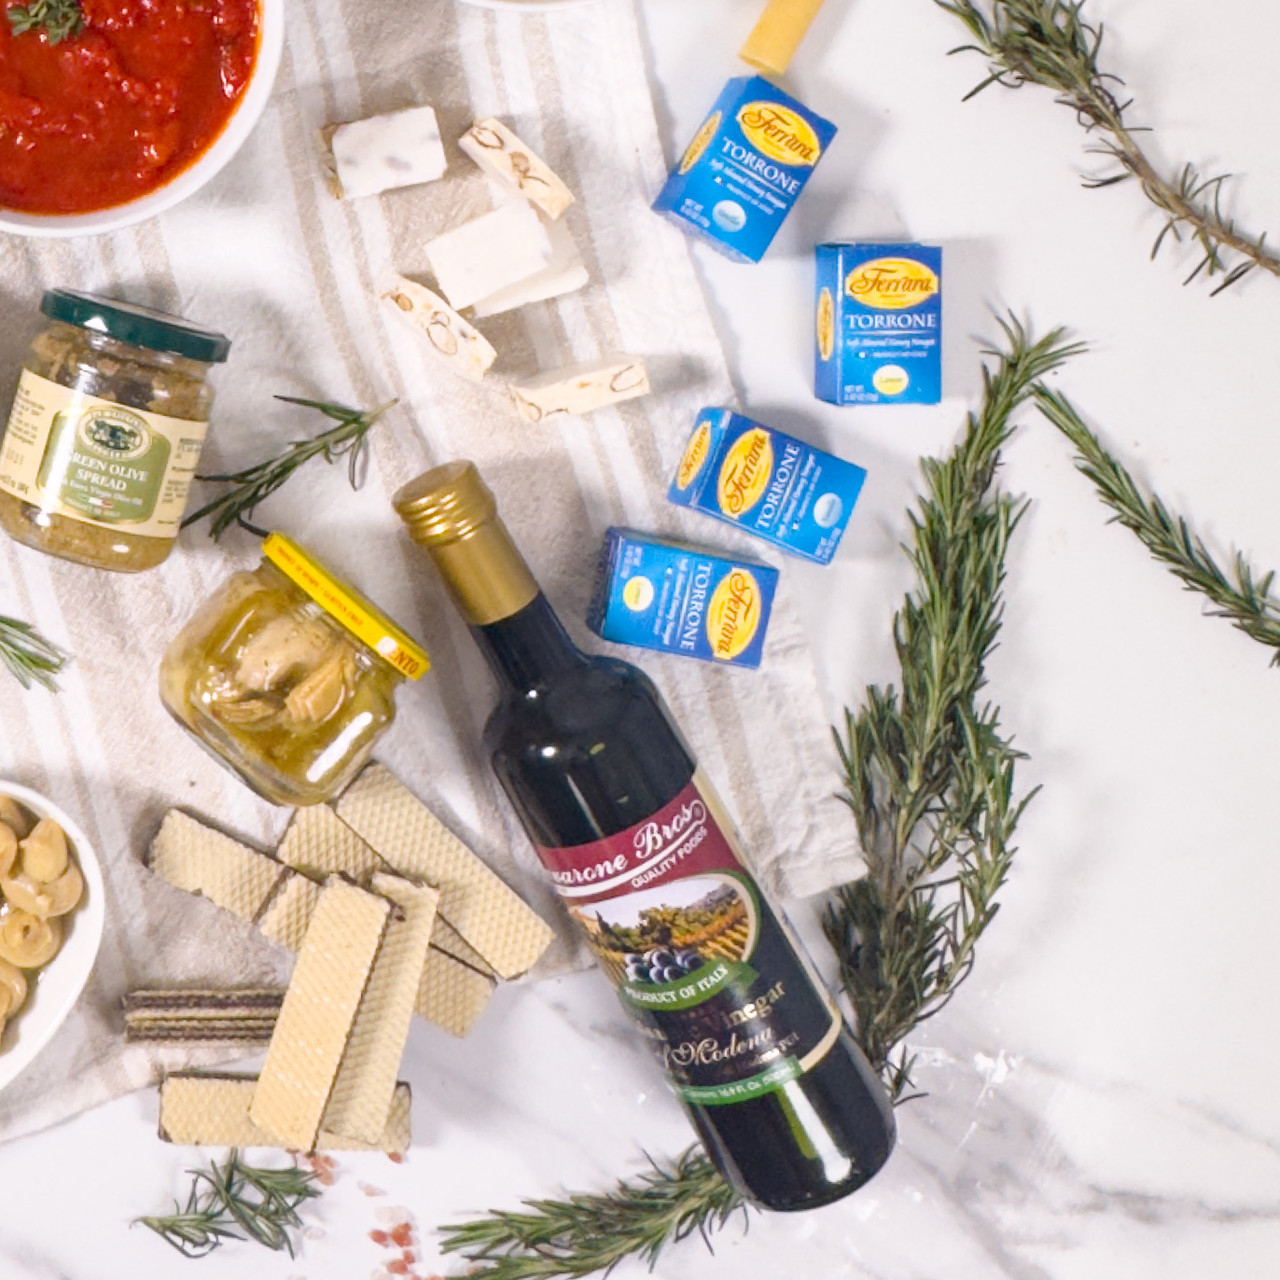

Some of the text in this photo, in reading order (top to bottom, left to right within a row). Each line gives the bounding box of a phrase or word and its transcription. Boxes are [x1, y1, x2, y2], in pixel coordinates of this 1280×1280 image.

[741, 107, 815, 162] Ferrara
[721, 136, 802, 196] TORRONE
[849, 267, 935, 296] Ferrara
[844, 313, 937, 329] TORRONE
[66, 451, 108, 472] REEN
[109, 464, 149, 482] OLIVE
[75, 468, 128, 492] SPREAD
[724, 432, 768, 515] Ferrara
[754, 443, 801, 529] TORRONE
[679, 561, 713, 651] TORRONE
[717, 572, 754, 653] Ferrara
[631, 825, 709, 889] QUALITY FOODS
[623, 963, 730, 1004] PRODUCT OF ITALY
[671, 1026, 772, 1067] Modena
